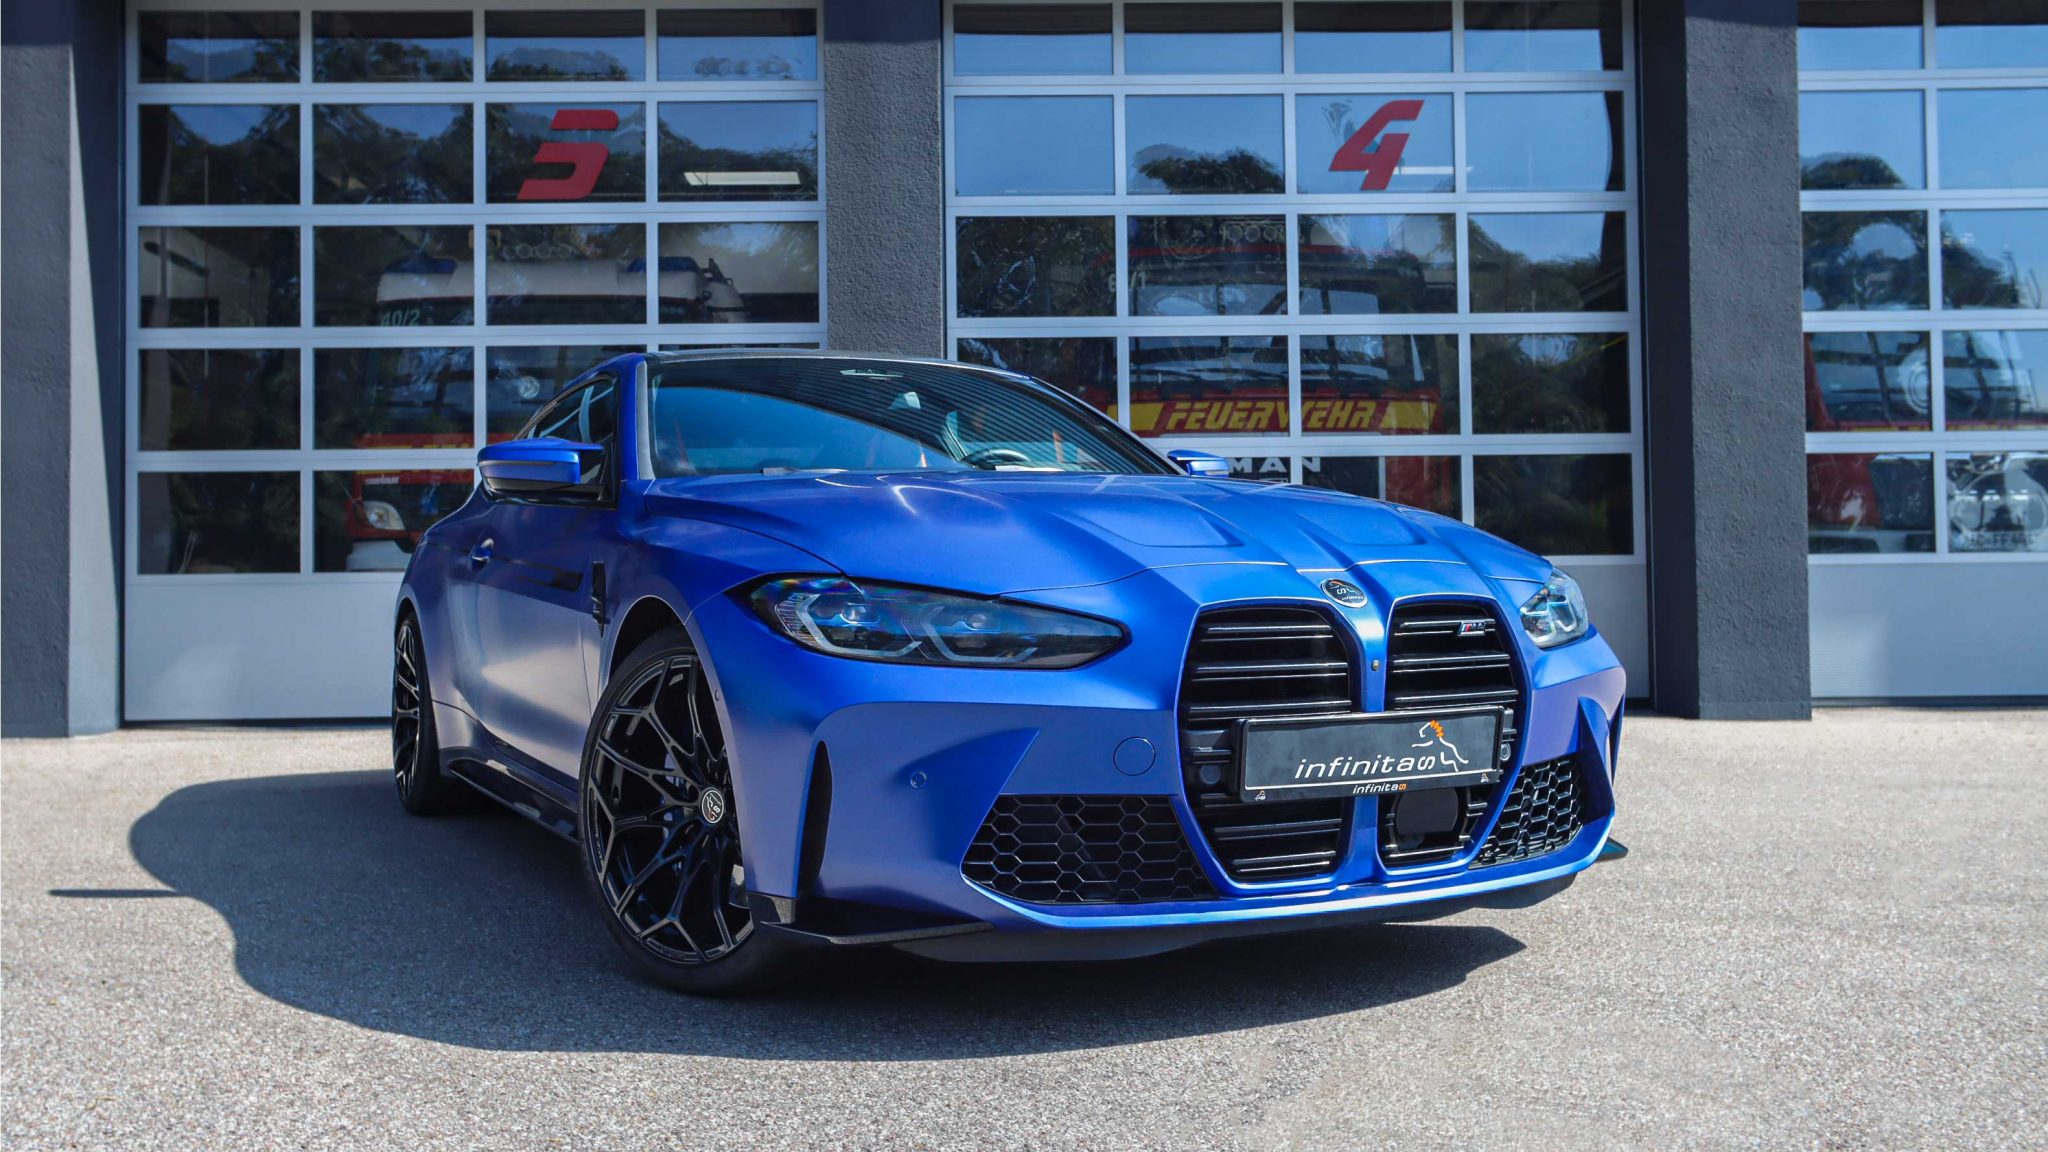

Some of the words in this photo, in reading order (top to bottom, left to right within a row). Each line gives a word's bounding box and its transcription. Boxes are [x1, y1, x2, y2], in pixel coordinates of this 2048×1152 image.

[1328, 100, 1425, 191] 4
[1165, 401, 1378, 430] FEUERWEHR
[1227, 457, 1321, 473] MAN
[1294, 754, 1436, 779] infinitas
[1352, 783, 1407, 794] infinitas
